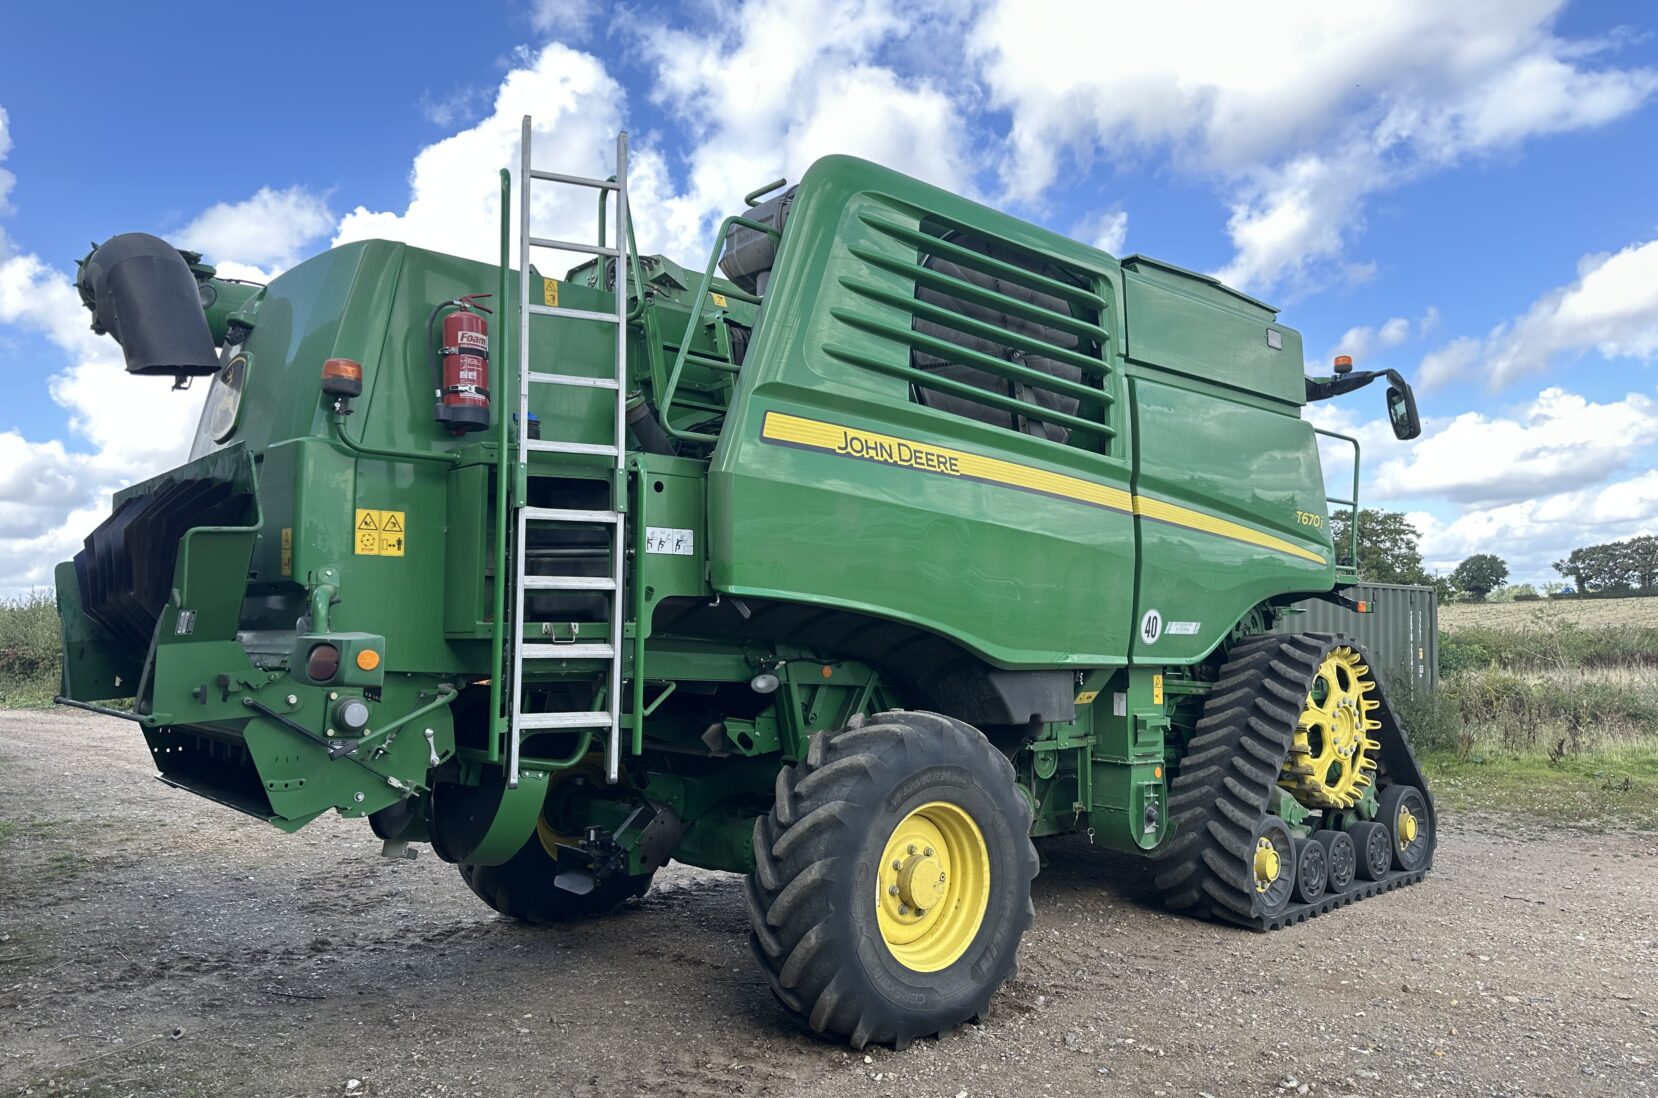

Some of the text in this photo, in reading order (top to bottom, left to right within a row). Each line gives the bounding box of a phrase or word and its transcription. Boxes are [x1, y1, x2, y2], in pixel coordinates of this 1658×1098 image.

[460, 332, 486, 346] Foam
[837, 431, 960, 473] JOHN DEERE
[1296, 511, 1324, 529] T670i
[1144, 615, 1158, 639] 40
